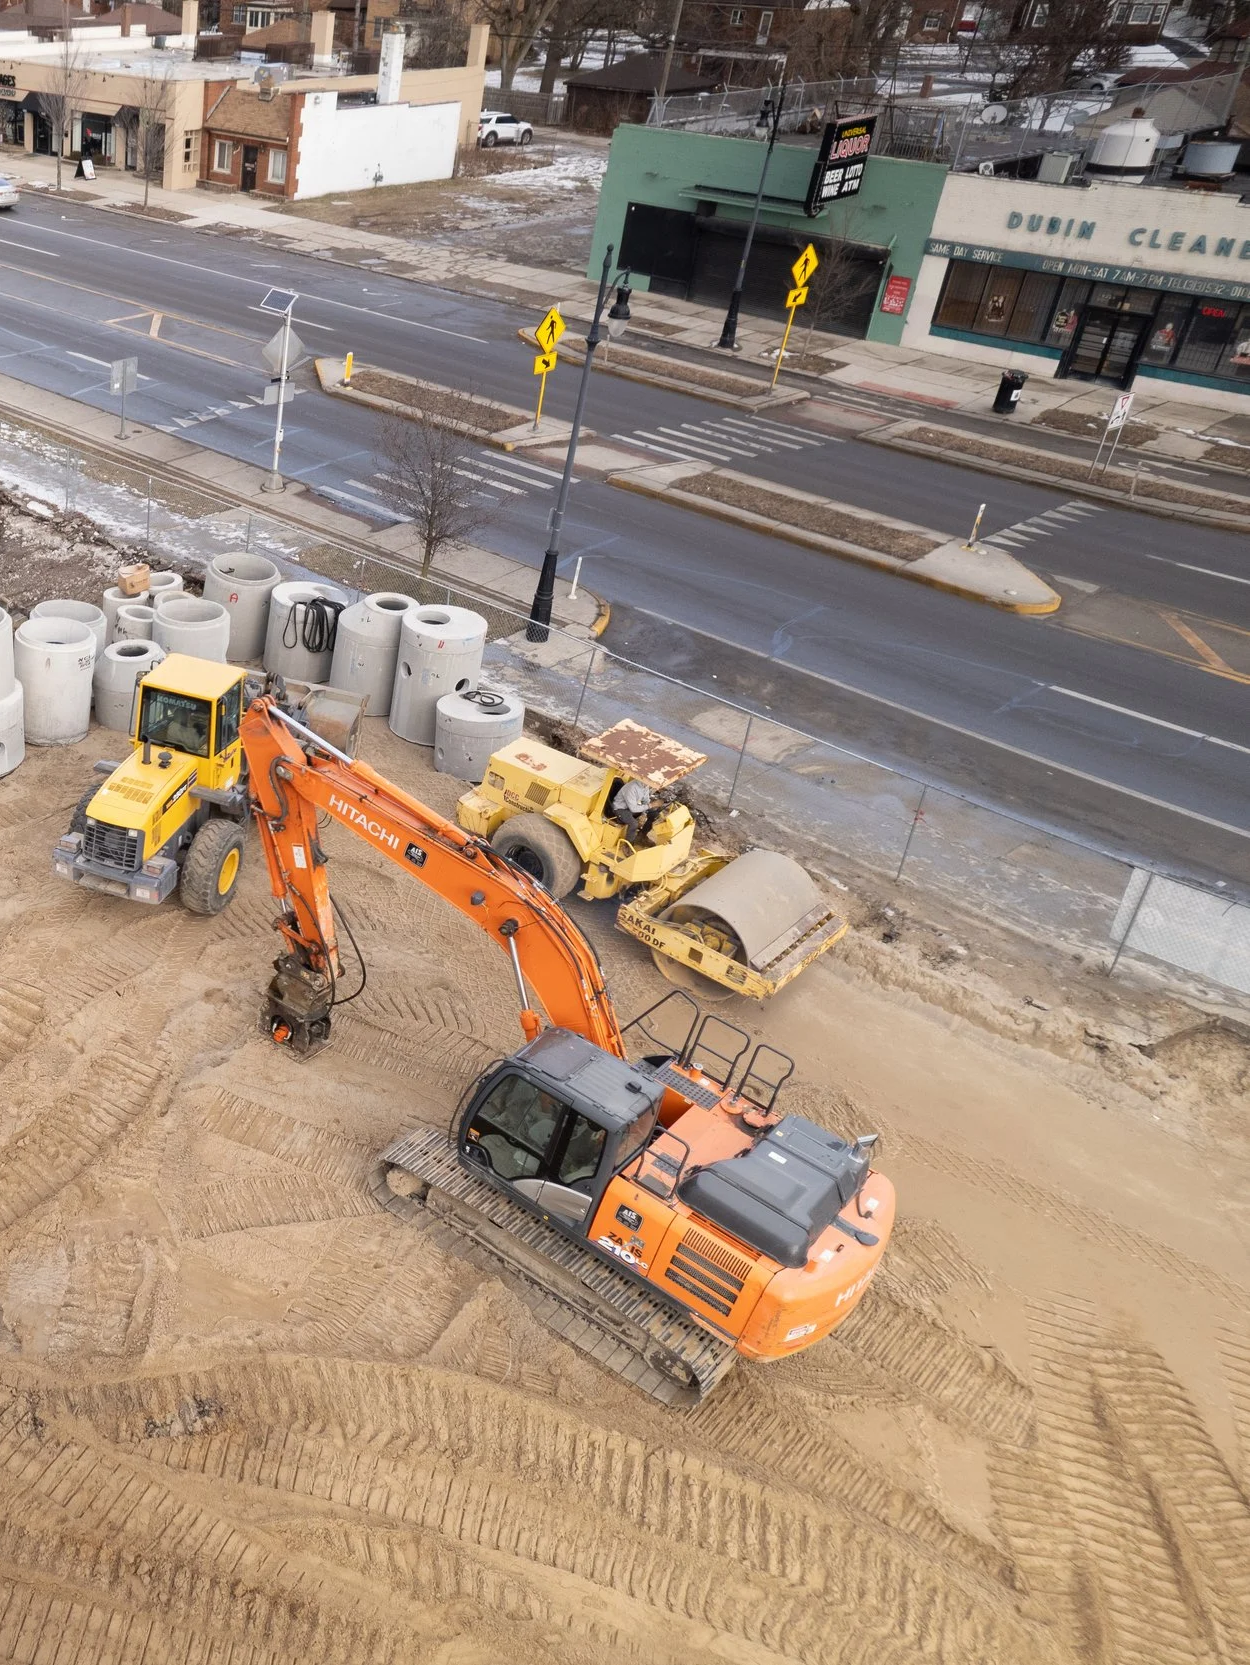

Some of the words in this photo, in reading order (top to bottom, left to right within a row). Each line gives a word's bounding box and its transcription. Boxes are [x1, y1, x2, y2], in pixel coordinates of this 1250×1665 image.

[830, 133, 870, 160] LIQUOR
[824, 167, 844, 185] BEER
[845, 163, 864, 180] LOTTO
[821, 182, 841, 198] WINE
[841, 178, 860, 193] ATM
[1006, 211, 1097, 241] DUBIN
[930, 242, 950, 255] SAME
[953, 246, 968, 257] DAY
[972, 249, 1004, 263] SERVICE
[1042, 260, 1064, 273] OPEN
[329, 794, 401, 850] HITACHI
[620, 911, 656, 935] SAKAI
